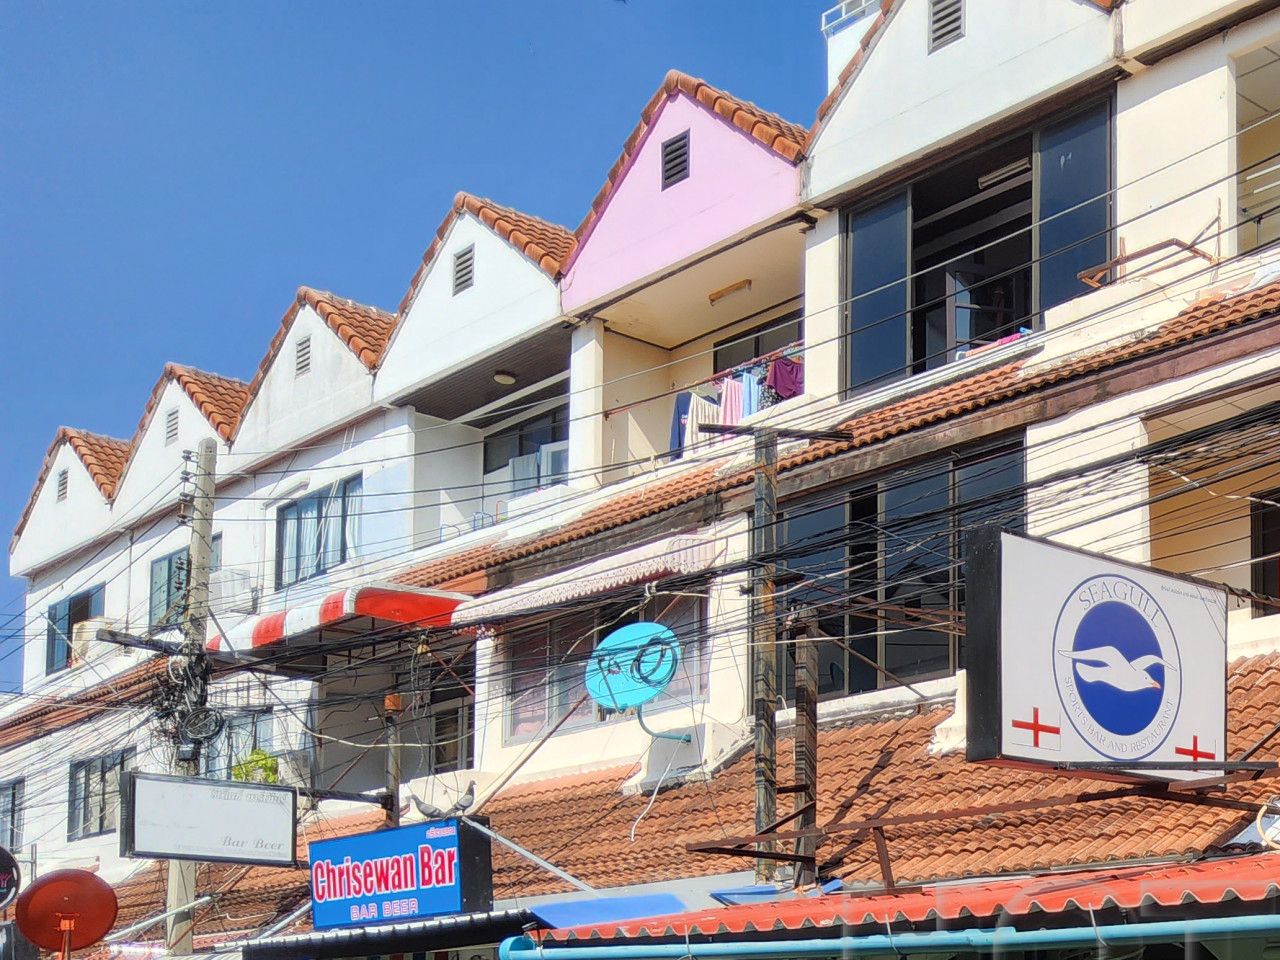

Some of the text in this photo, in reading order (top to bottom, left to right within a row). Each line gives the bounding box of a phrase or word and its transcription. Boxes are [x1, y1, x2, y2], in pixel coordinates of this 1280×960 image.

[1078, 581, 1160, 628] SEAGULL
[1063, 676, 1174, 753] SPORTS BAR AND RESTAURANT
[222, 835, 285, 851] Bar Beer
[312, 844, 458, 903] Chrisewan Bar
[350, 898, 418, 921] BAR BEER
